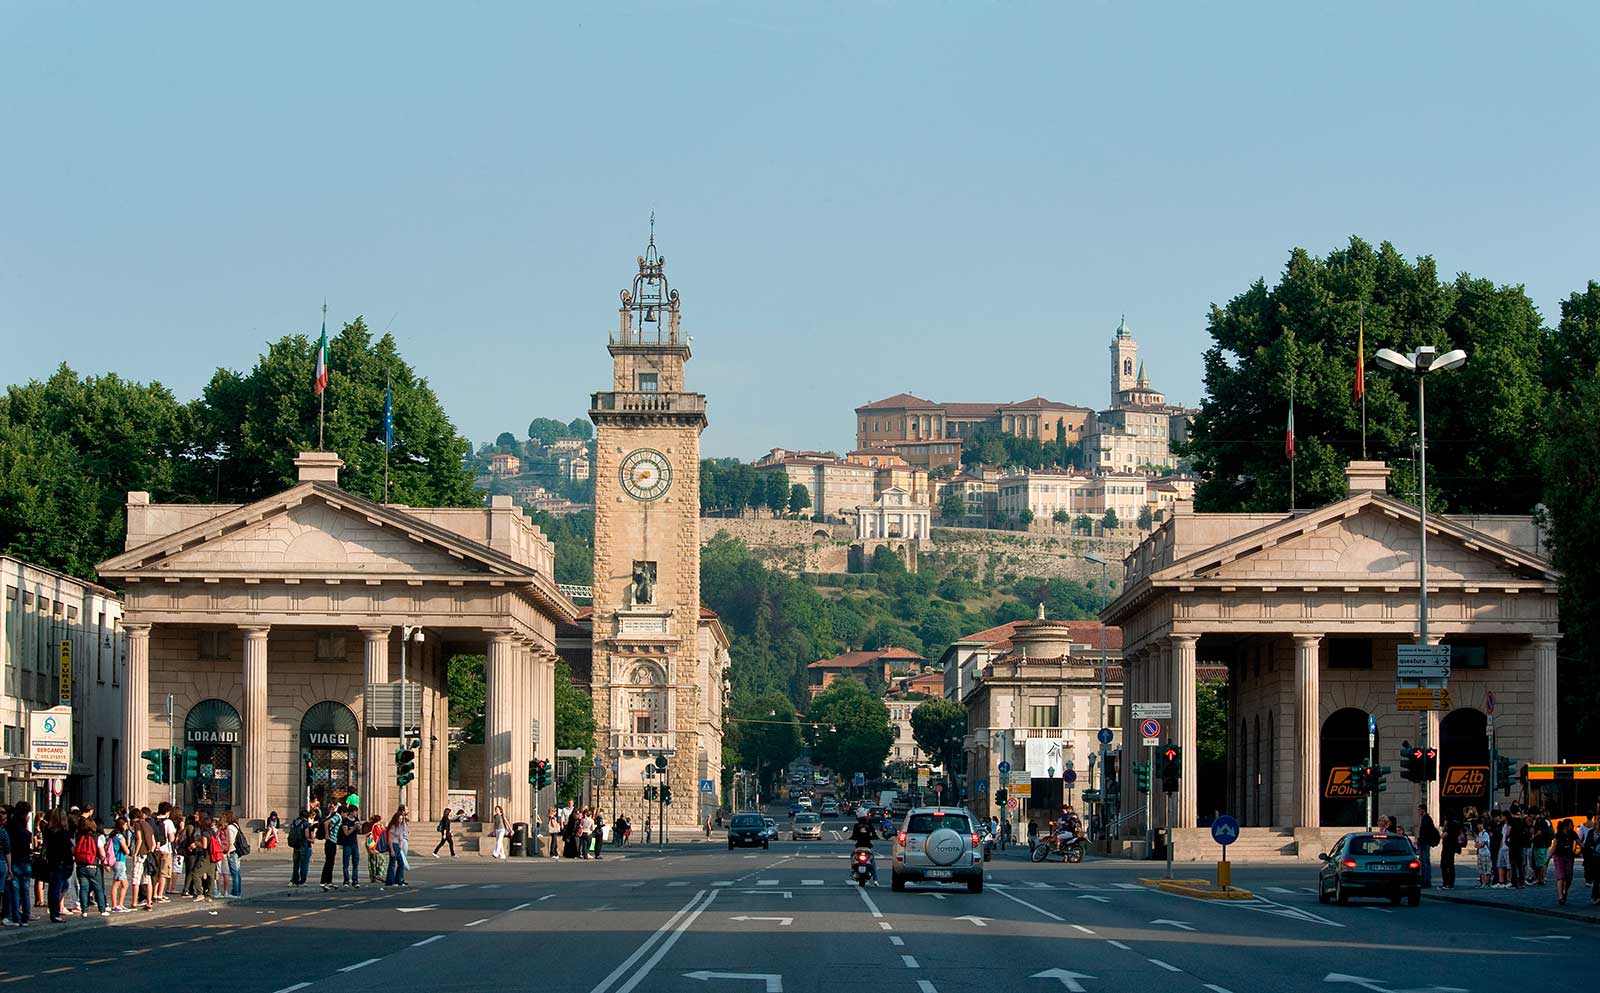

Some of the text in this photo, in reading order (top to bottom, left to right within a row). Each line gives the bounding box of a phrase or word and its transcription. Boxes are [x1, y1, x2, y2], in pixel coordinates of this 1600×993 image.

[62, 641, 70, 657] BAR
[61, 663, 70, 699] TURISMO
[187, 731, 238, 742] LORANDI
[309, 733, 350, 744] VIAGGI
[1329, 784, 1362, 795] POIN
[1446, 784, 1482, 794] POINT
